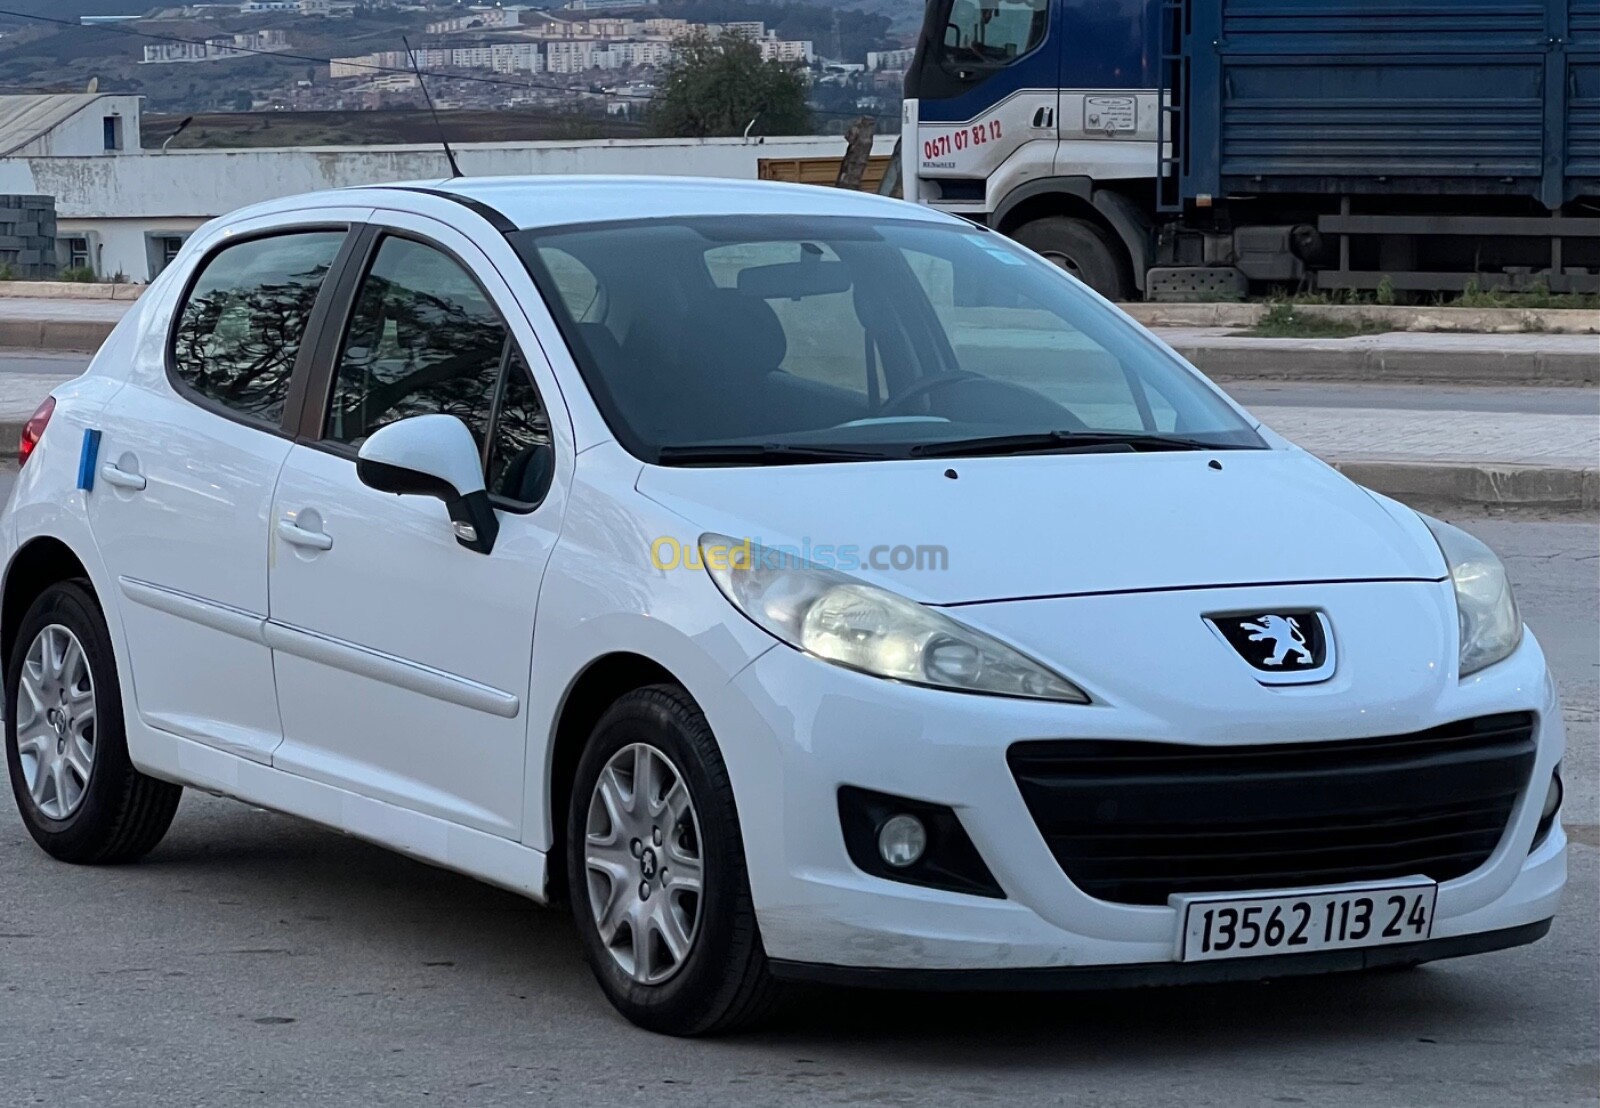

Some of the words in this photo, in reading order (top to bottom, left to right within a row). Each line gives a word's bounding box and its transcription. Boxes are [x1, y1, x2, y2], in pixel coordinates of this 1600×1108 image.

[924, 134, 951, 160] 0671
[954, 130, 968, 150] 07
[972, 124, 987, 145] 82
[989, 120, 1002, 140] 12
[1202, 901, 1312, 953] 13562
[1324, 897, 1374, 942] 113
[1382, 894, 1426, 938] 24
